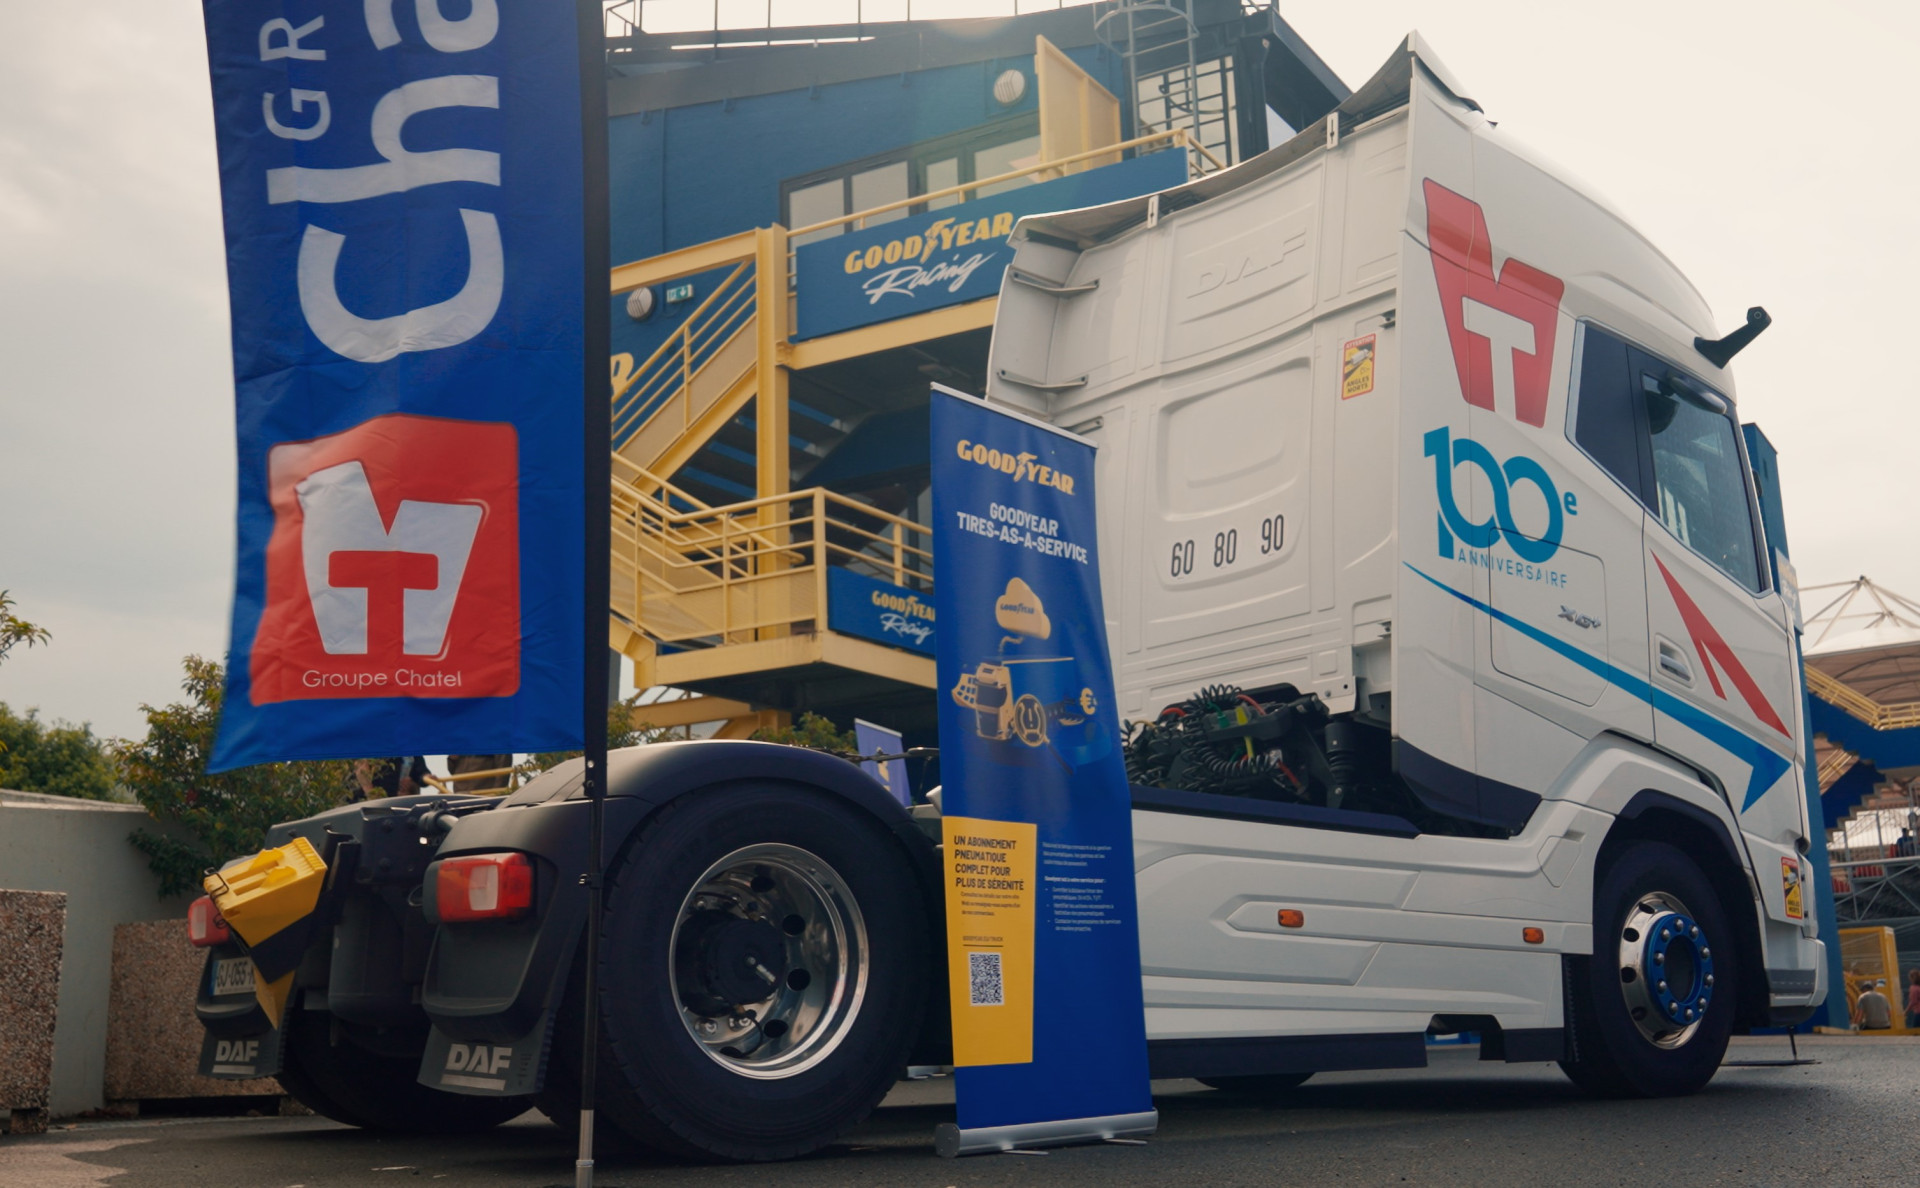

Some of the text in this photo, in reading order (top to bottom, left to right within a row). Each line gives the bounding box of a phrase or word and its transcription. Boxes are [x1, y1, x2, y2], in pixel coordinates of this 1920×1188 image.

[844, 212, 1014, 274] GOODYEAR
[862, 252, 998, 304] Racing
[1186, 226, 1307, 299] DAF
[957, 439, 1076, 496] GOODYEAR
[989, 502, 1059, 537] GOODYEAR
[957, 511, 1088, 565] TIRES-AS-A-SERVICE
[1171, 514, 1284, 577] 60 80 90
[880, 613, 935, 645] Racing
[302, 669, 462, 690] Groupe Chatel
[954, 835, 1017, 850] UN ABONNEMENT
[954, 849, 1007, 863] PNEUMATIQUE
[955, 863, 1011, 876] COMPLET POUR
[955, 877, 976, 888] PLUS
[977, 878, 986, 889] DE
[215, 1040, 259, 1063] DAF
[445, 1043, 513, 1075] DAF
